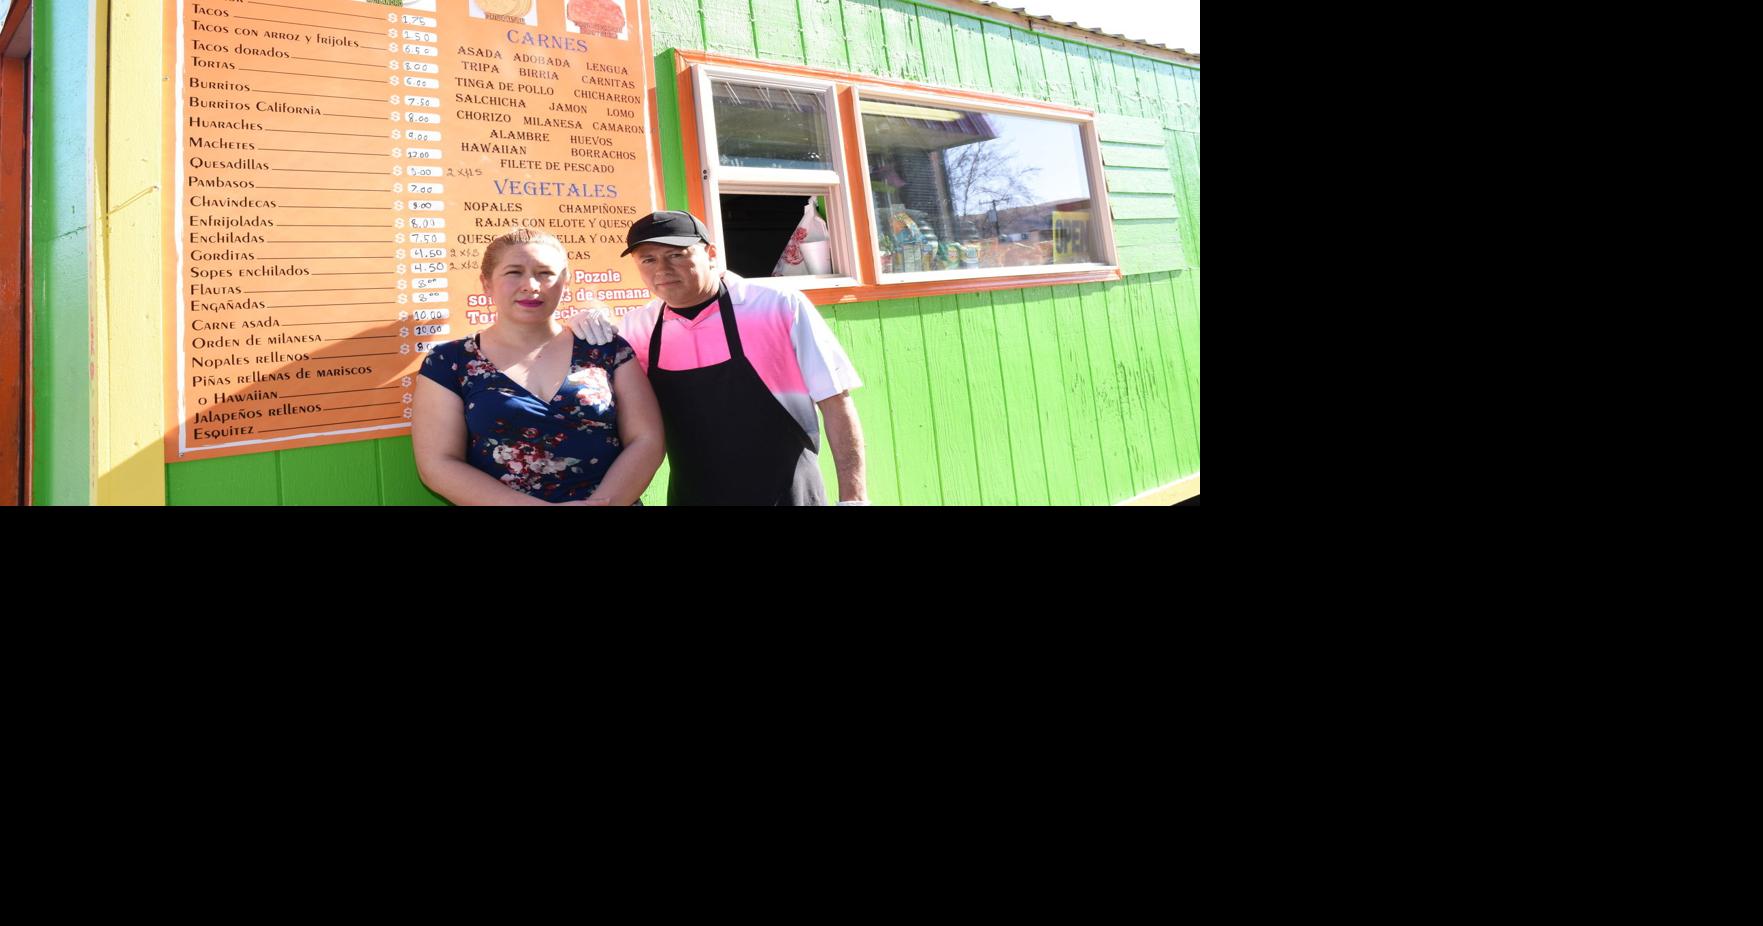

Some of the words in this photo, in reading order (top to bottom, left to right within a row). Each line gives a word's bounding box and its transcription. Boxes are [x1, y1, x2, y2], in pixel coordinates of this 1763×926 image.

[193, 3, 229, 17] Tacos
[192, 20, 228, 34] Tacos
[317, 34, 359, 48] frijoles
[507, 30, 588, 52] CARNES
[192, 40, 228, 53] Tacos
[235, 44, 290, 58] dorados
[191, 56, 235, 70] Tortas
[458, 46, 502, 59] ASADA
[513, 53, 570, 67] ADOBADA
[586, 62, 628, 75] LENGUA
[462, 61, 499, 73] TRIPA
[519, 68, 559, 80] BIRRIA
[582, 76, 635, 89] CARNITAS
[190, 77, 250, 91] Burritos
[455, 77, 494, 89] TINGA
[499, 82, 513, 91] DE
[518, 84, 554, 95] POLLO
[574, 90, 641, 104] CHICHARRON
[190, 97, 250, 110] Burritos
[256, 101, 321, 115] California
[456, 94, 526, 108] SALCHICHA
[549, 103, 587, 114] JAMON
[607, 109, 634, 118] LOMO
[190, 117, 263, 131] Huaraches
[457, 110, 511, 122] CHORIZO
[524, 116, 583, 129] MILANESA
[593, 122, 644, 134] CAMARON
[190, 137, 254, 150] Machetes
[490, 130, 550, 142] ALAMBRE
[571, 136, 612, 146] HUEVOS
[461, 143, 526, 155] HAWAIIAN
[571, 148, 636, 160] BORRACHOS
[190, 157, 269, 170] Quesadillas
[501, 159, 542, 170] FILETE
[545, 162, 560, 170] DE
[564, 163, 614, 174] PESCADO
[189, 176, 254, 189] Pambasos
[494, 178, 617, 198] VEGETALES
[190, 196, 276, 208] Chavindecas
[464, 202, 522, 212] NOPALES
[559, 203, 636, 214] CHAMPIÑONES
[190, 215, 274, 229] Enfrijoladas
[475, 218, 519, 228] RAJAS
[522, 218, 544, 228] CON
[550, 219, 585, 228] ELOTE
[190, 232, 265, 244] Enchiladas
[191, 250, 254, 261] Gorditas
[191, 267, 232, 279] Sopes
[239, 265, 309, 276] enchilados
[575, 269, 621, 282] Pozole
[191, 284, 242, 295] Flautas
[598, 288, 650, 300] semana
[192, 336, 240, 349] Orden
[268, 333, 322, 344] milanesa
[192, 354, 249, 369] Nopales
[256, 352, 309, 364] rellenos
[238, 371, 290, 384] rellenas
[317, 366, 372, 378] mariscos
[214, 390, 278, 404] Hawaiian
[269, 404, 321, 416] rellenos
[194, 426, 254, 439] Esquitez
